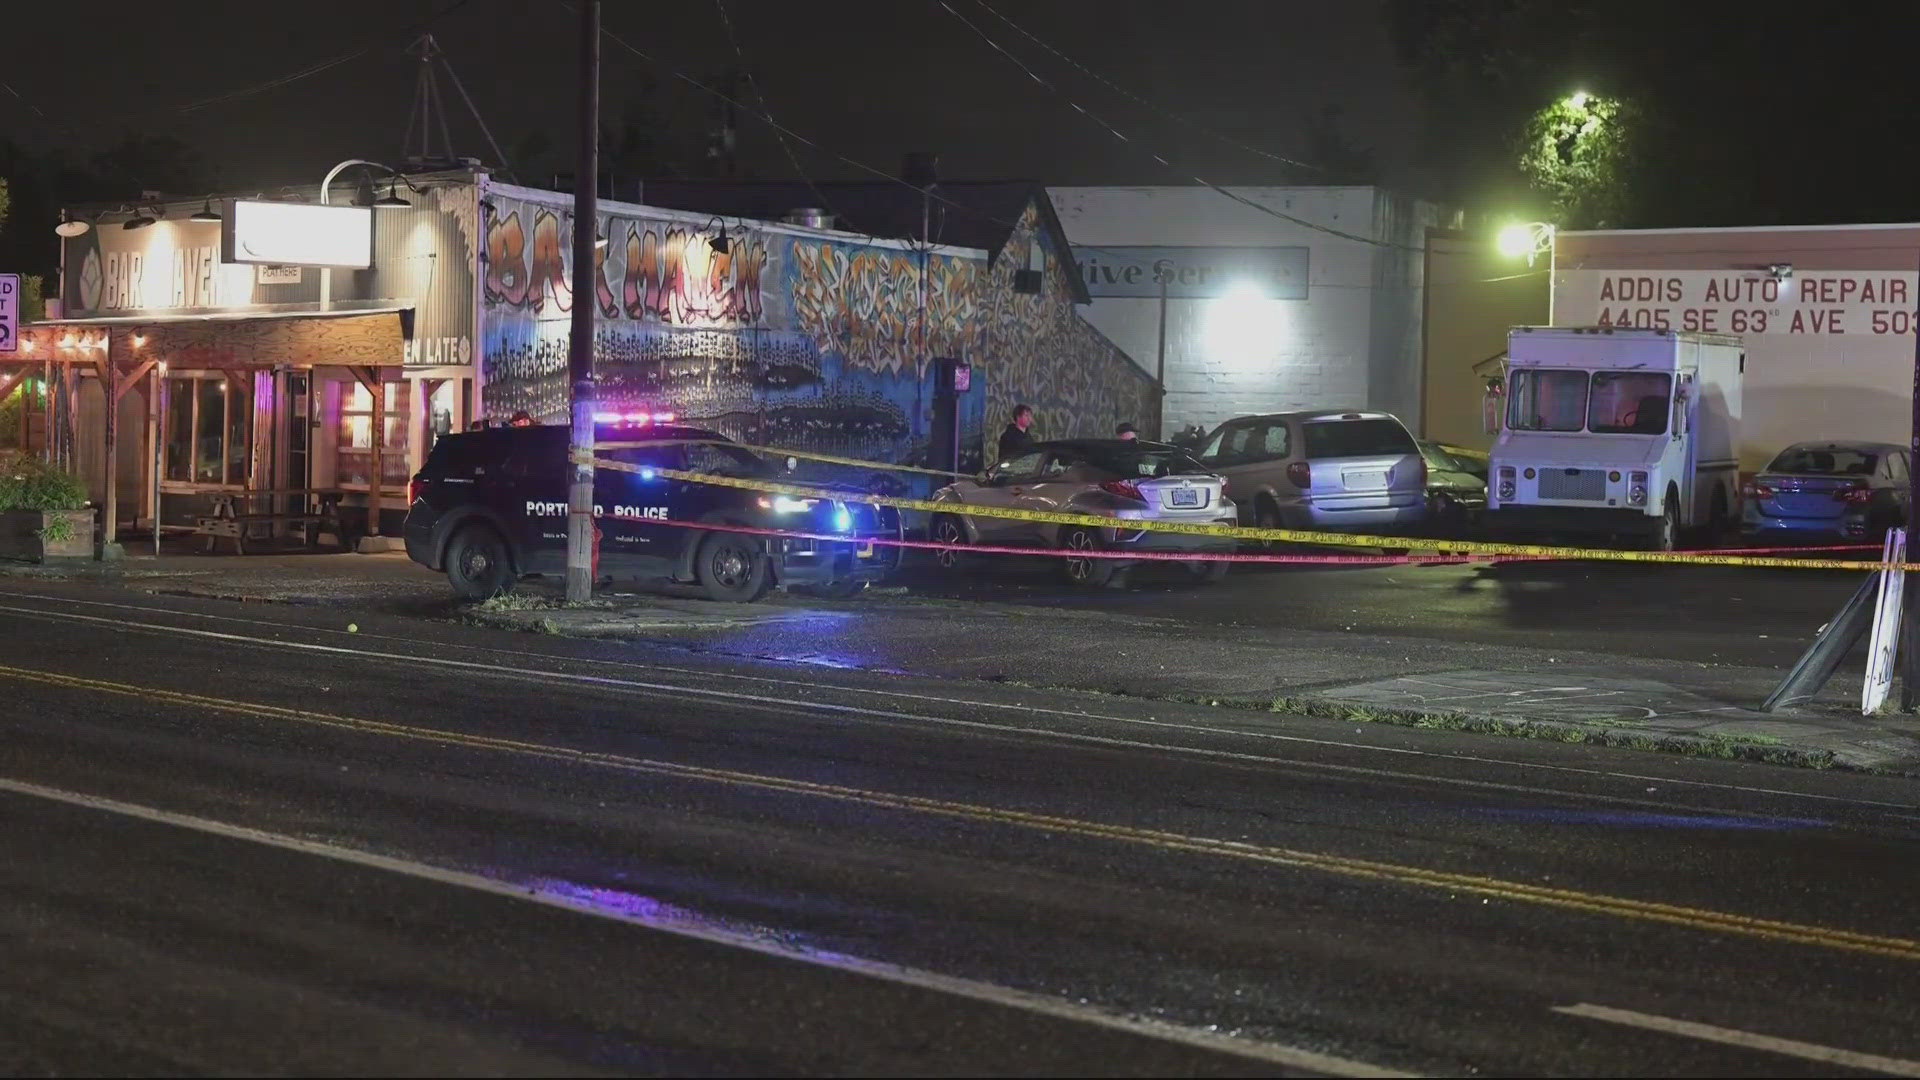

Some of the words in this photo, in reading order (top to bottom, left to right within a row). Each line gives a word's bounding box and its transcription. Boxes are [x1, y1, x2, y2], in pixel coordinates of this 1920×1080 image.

[105, 251, 144, 309] BAR
[1077, 258, 1143, 285] tive
[1600, 277, 1683, 302] ADDIS
[1705, 278, 1779, 303] AUTO
[1801, 278, 1907, 304] REPAIR
[1598, 307, 1671, 331] 4405
[1683, 309, 1719, 333] SE
[1790, 309, 1845, 334] AVE
[404, 338, 421, 363] EN
[426, 337, 458, 364] LATE
[614, 505, 669, 520] POLICE
